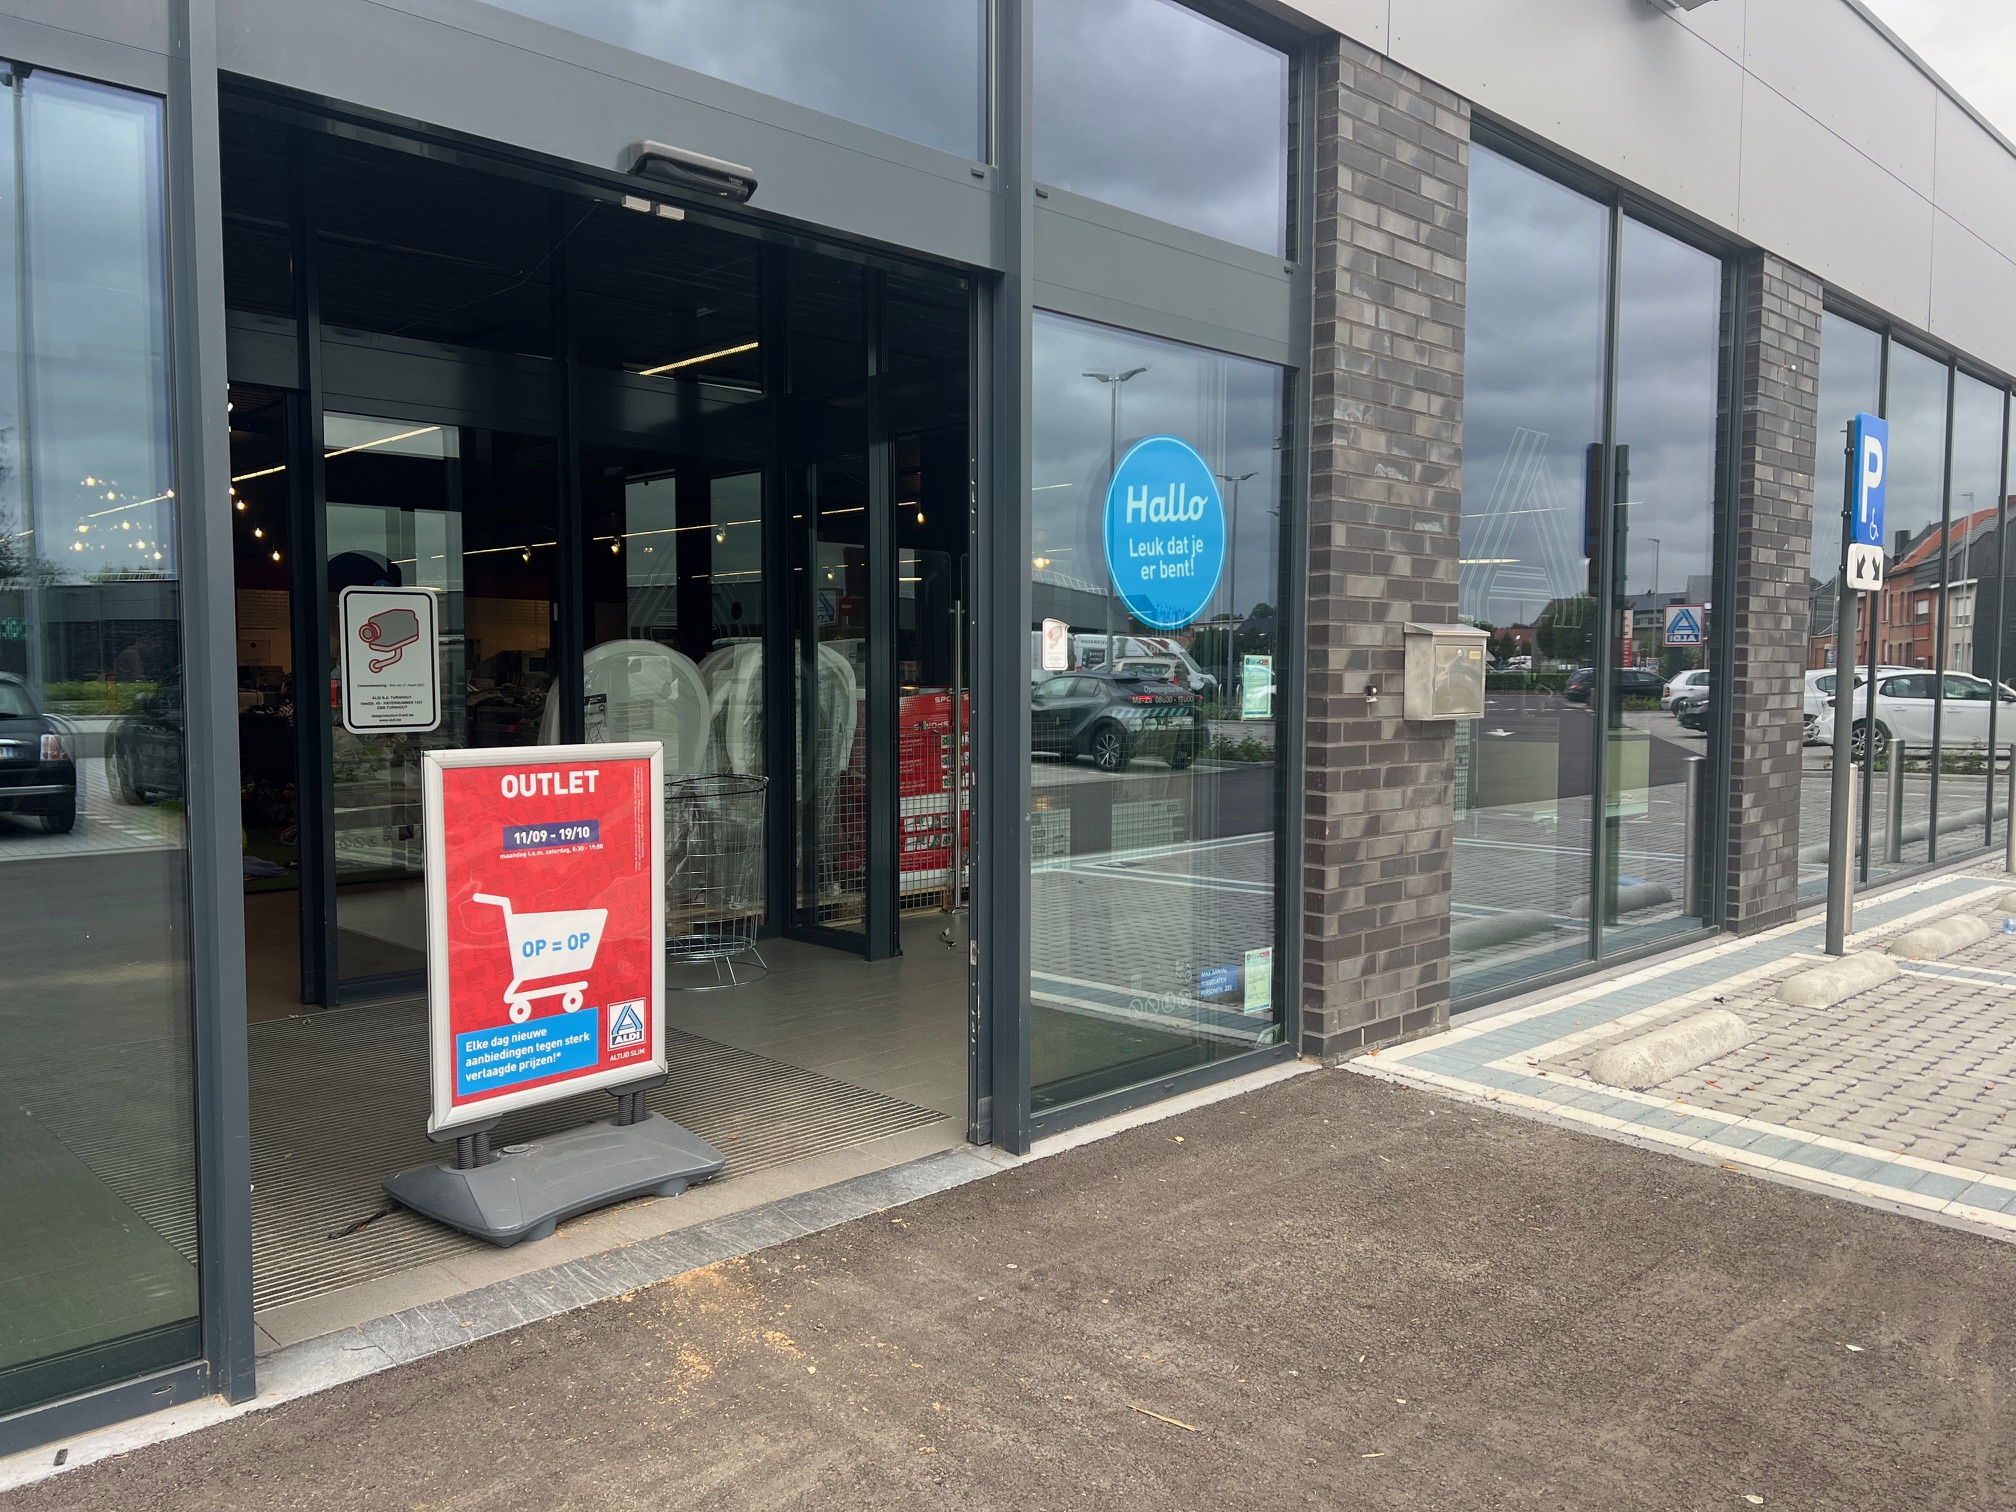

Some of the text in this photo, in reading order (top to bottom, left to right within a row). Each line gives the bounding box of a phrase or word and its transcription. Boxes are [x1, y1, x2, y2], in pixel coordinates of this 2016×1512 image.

[1861, 434, 1883, 523] P
[1126, 482, 1208, 523] Hallo
[1129, 534, 1204, 558] Leuk dat je
[1141, 558, 1195, 580] er bent!
[935, 694, 969, 704] SPOS
[501, 770, 600, 798] OUTLET
[514, 829, 548, 845] 11/09
[559, 826, 590, 841] 19/10
[500, 851, 527, 859] maandag
[522, 932, 591, 958] OP = OP
[1201, 976, 1227, 987] TOEGELATEN
[466, 1028, 547, 1053] Elke dag nieuwe
[614, 1032, 641, 1045] ALDI
[465, 1032, 590, 1068] aanbiedingen tegen sterk
[609, 1048, 645, 1062] ALTIJD SLIM
[466, 1063, 517, 1082] verlaagde
